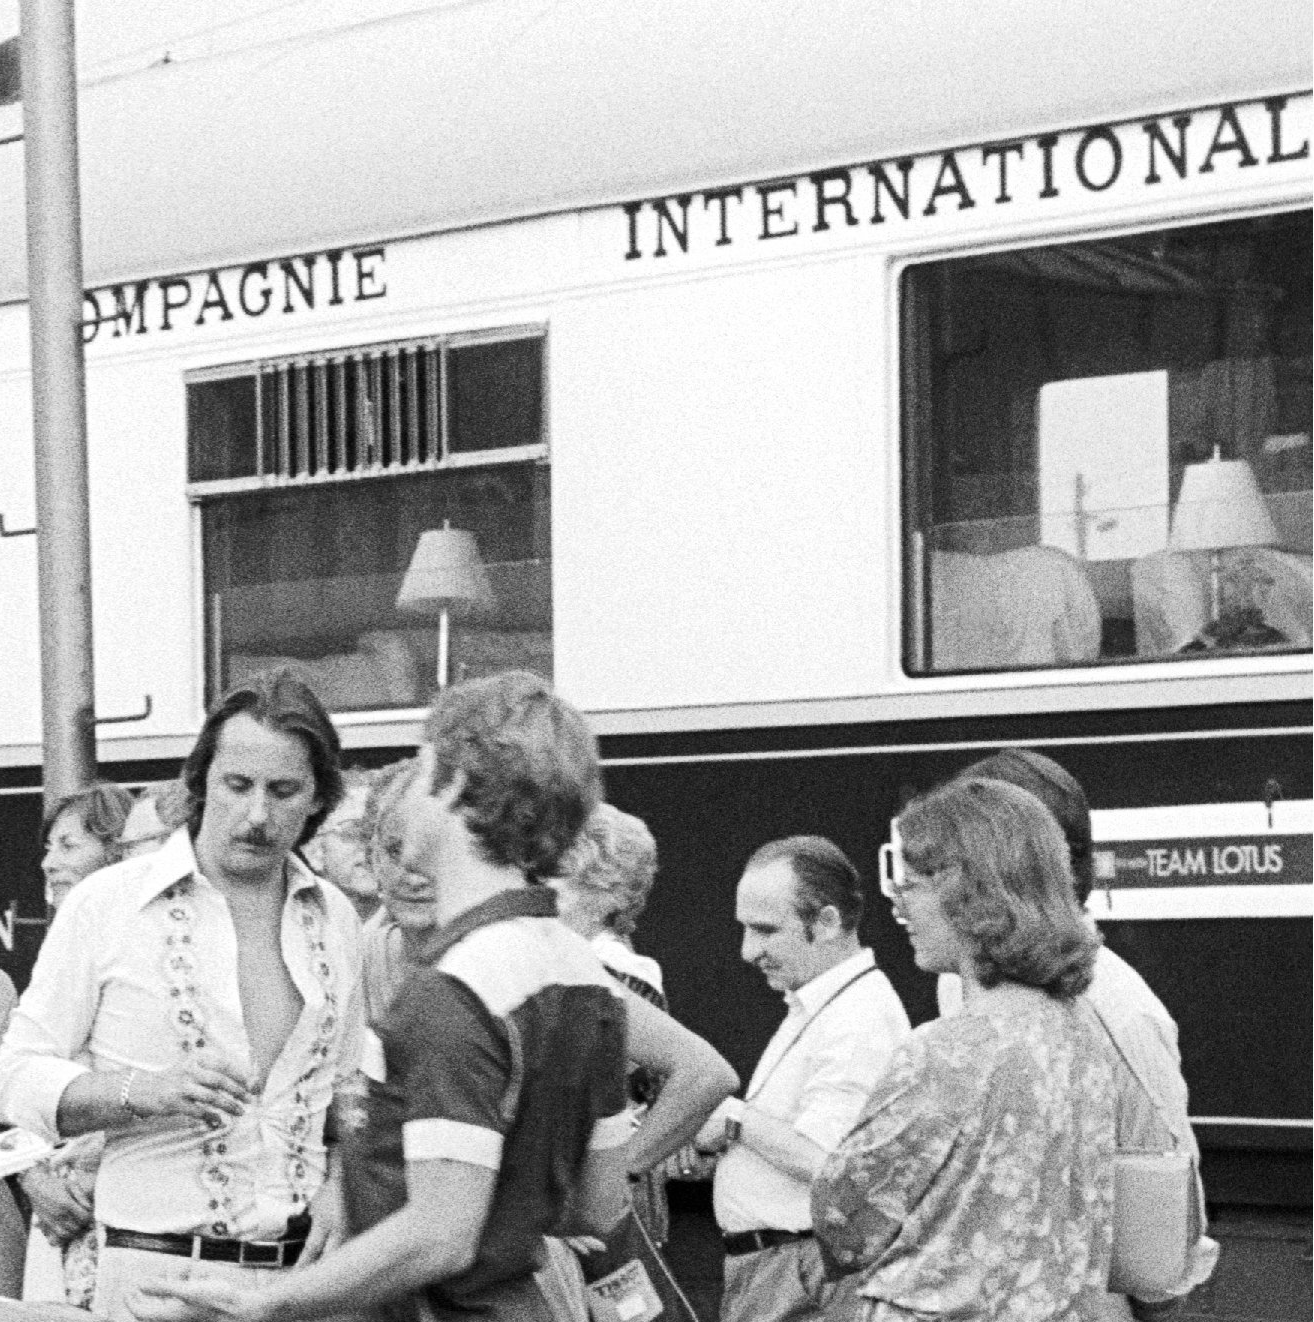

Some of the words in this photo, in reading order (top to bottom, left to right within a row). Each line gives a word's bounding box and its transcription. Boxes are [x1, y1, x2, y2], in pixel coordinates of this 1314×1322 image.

[624, 98, 1309, 260] INTERNATIONAL
[1145, 848, 1207, 877] TEAM
[1212, 844, 1284, 875] LOTUS
